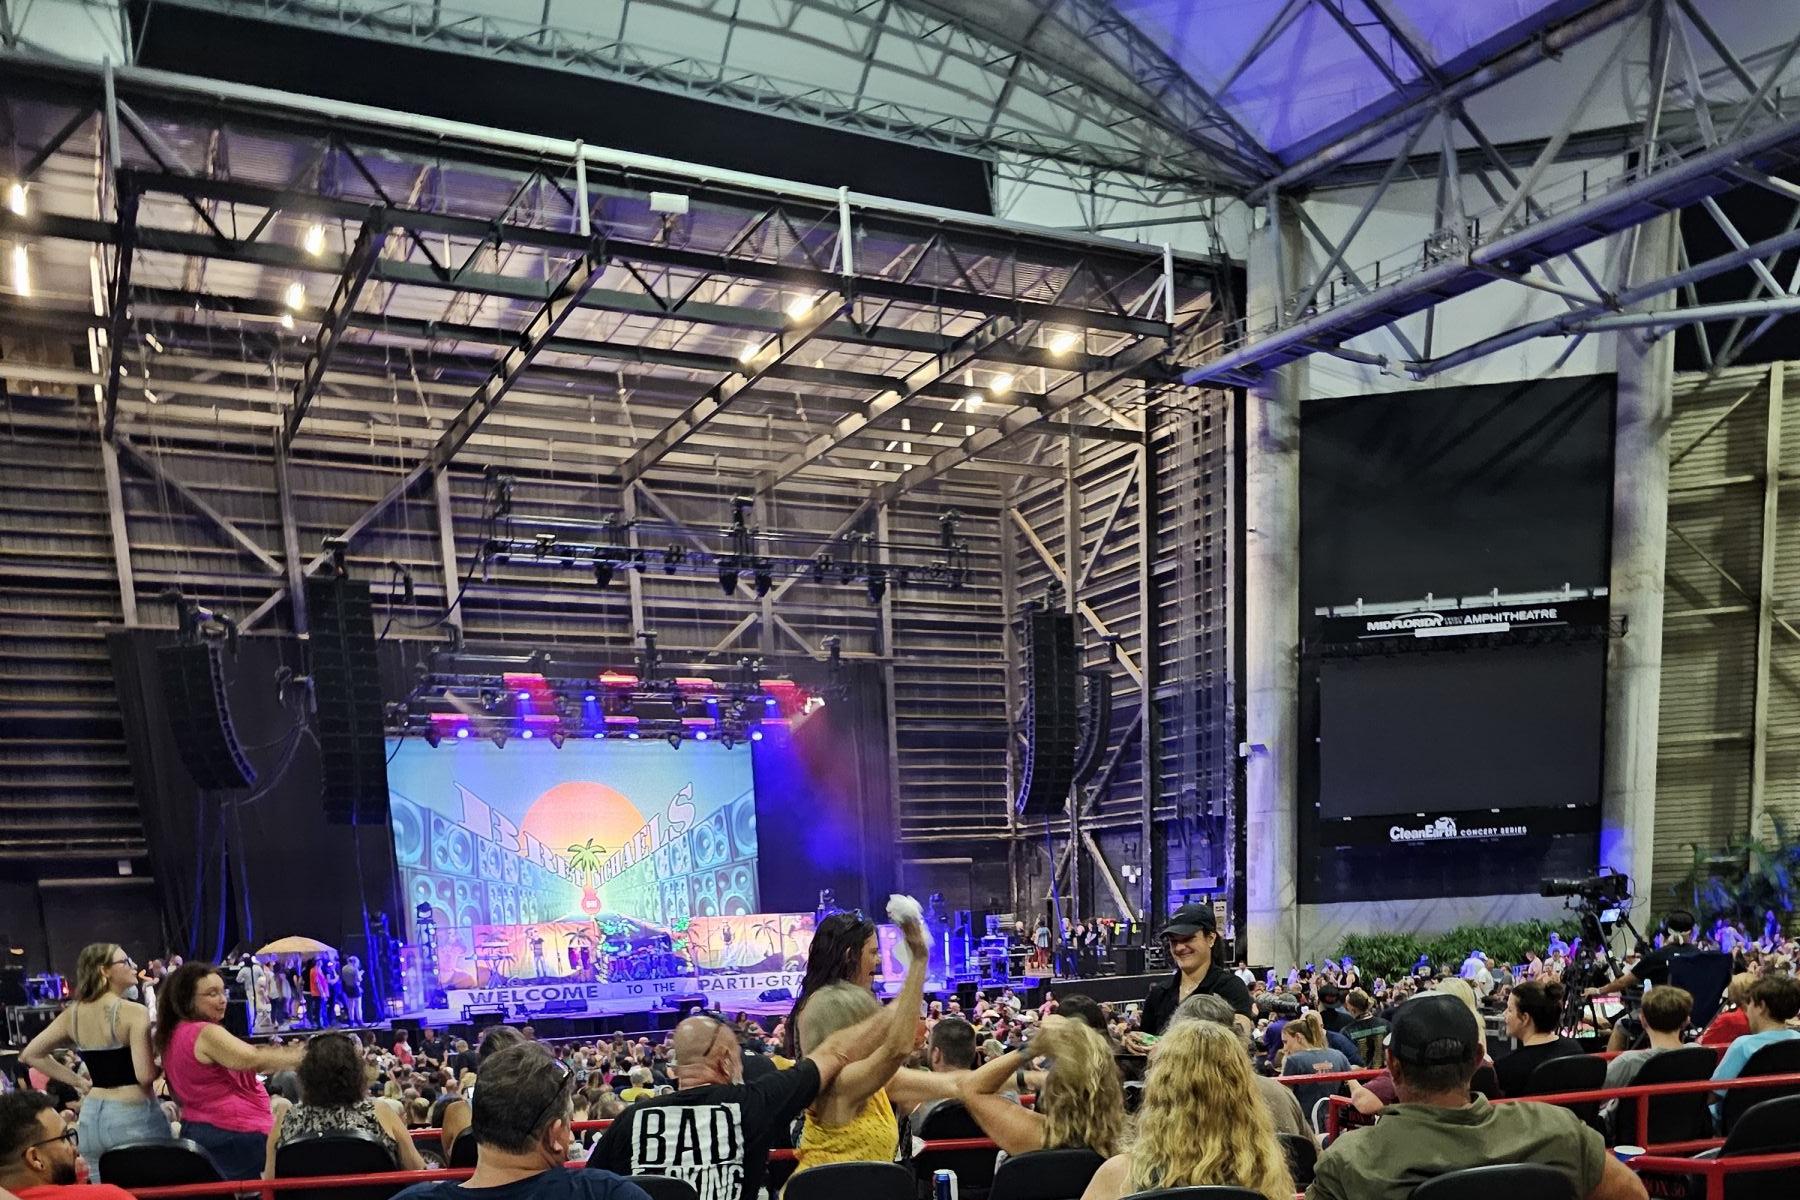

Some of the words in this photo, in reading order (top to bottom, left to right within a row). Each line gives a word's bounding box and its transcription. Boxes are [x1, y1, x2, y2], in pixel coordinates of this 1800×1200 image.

[1366, 614, 1443, 632] MIDFLORIDA
[1463, 608, 1558, 625] AMPHITHEATRE
[453, 780, 586, 888] BRET
[1389, 822, 1457, 841] CleanEarth
[468, 984, 599, 1004] WELCOME
[626, 983, 644, 995] TO
[653, 982, 676, 993] THE
[700, 975, 805, 991] PARTI-GRA
[638, 1107, 738, 1166] BAD
